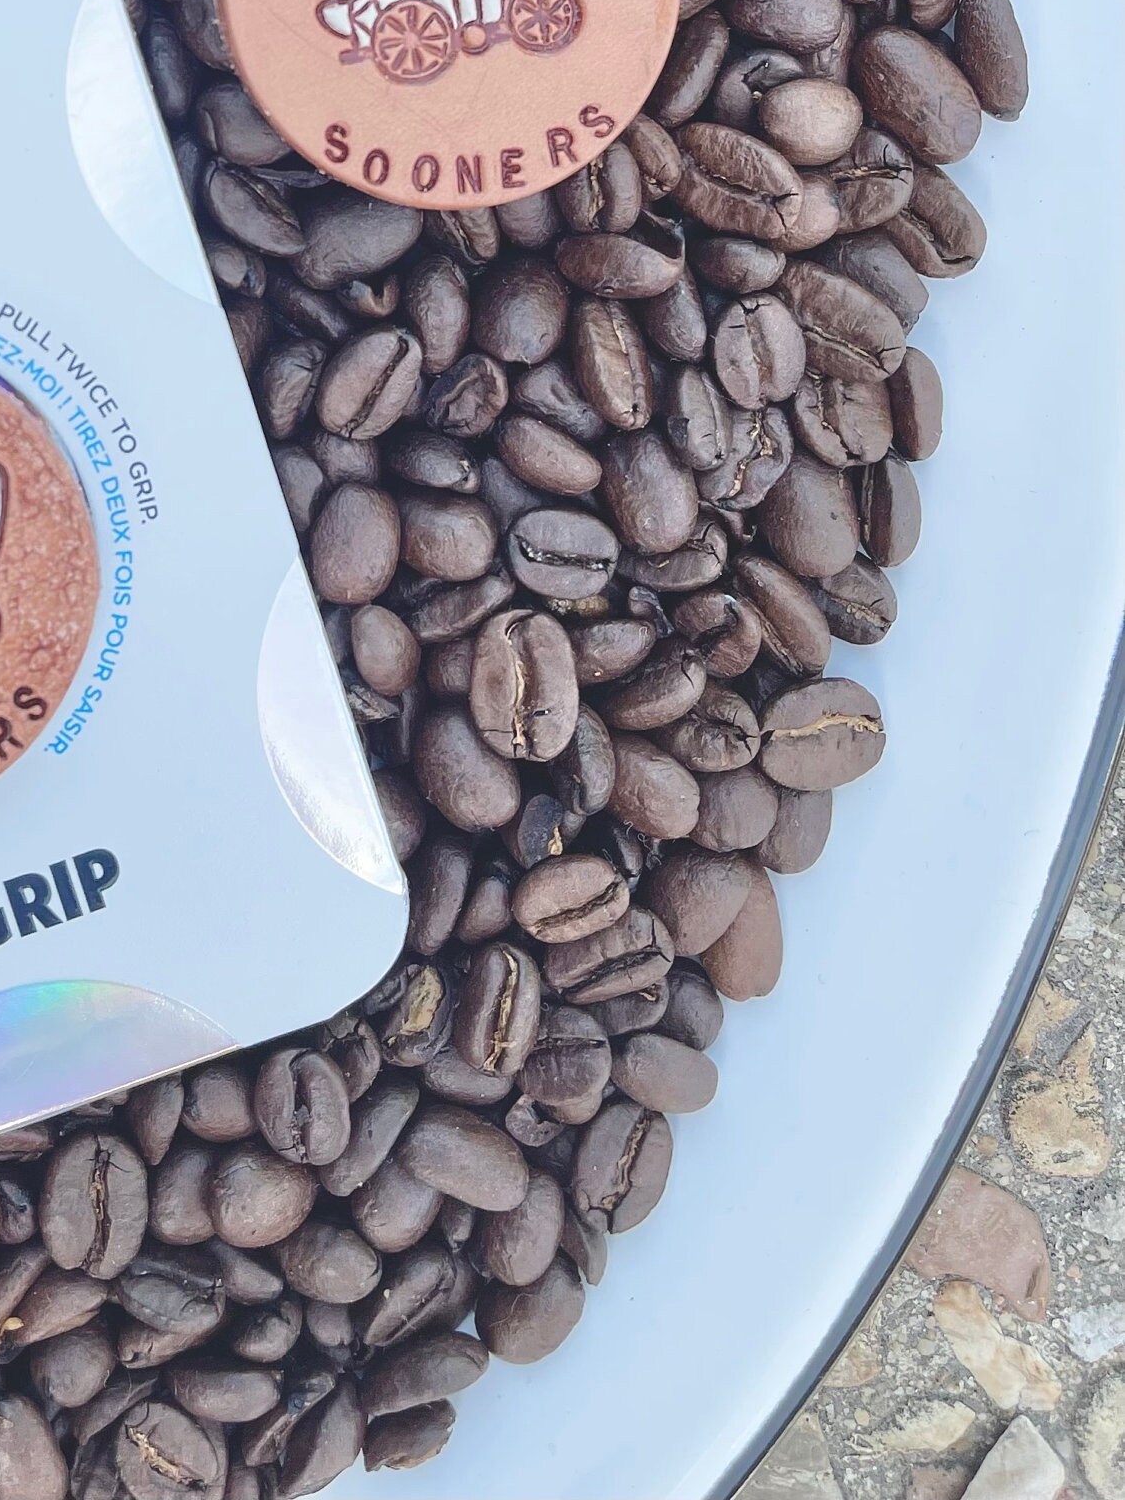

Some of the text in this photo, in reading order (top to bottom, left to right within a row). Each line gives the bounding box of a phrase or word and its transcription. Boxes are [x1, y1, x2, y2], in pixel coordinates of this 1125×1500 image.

[324, 104, 616, 195] SOONERS
[56, 343, 118, 418] TWICE
[111, 418, 137, 454] TO
[129, 461, 159, 525] GRIP.
[68, 406, 112, 473] TIREZ
[101, 476, 131, 543] DEUX
[113, 550, 133, 605] FOIS
[93, 614, 128, 681] POUR
[44, 685, 103, 755] SAISIR.
